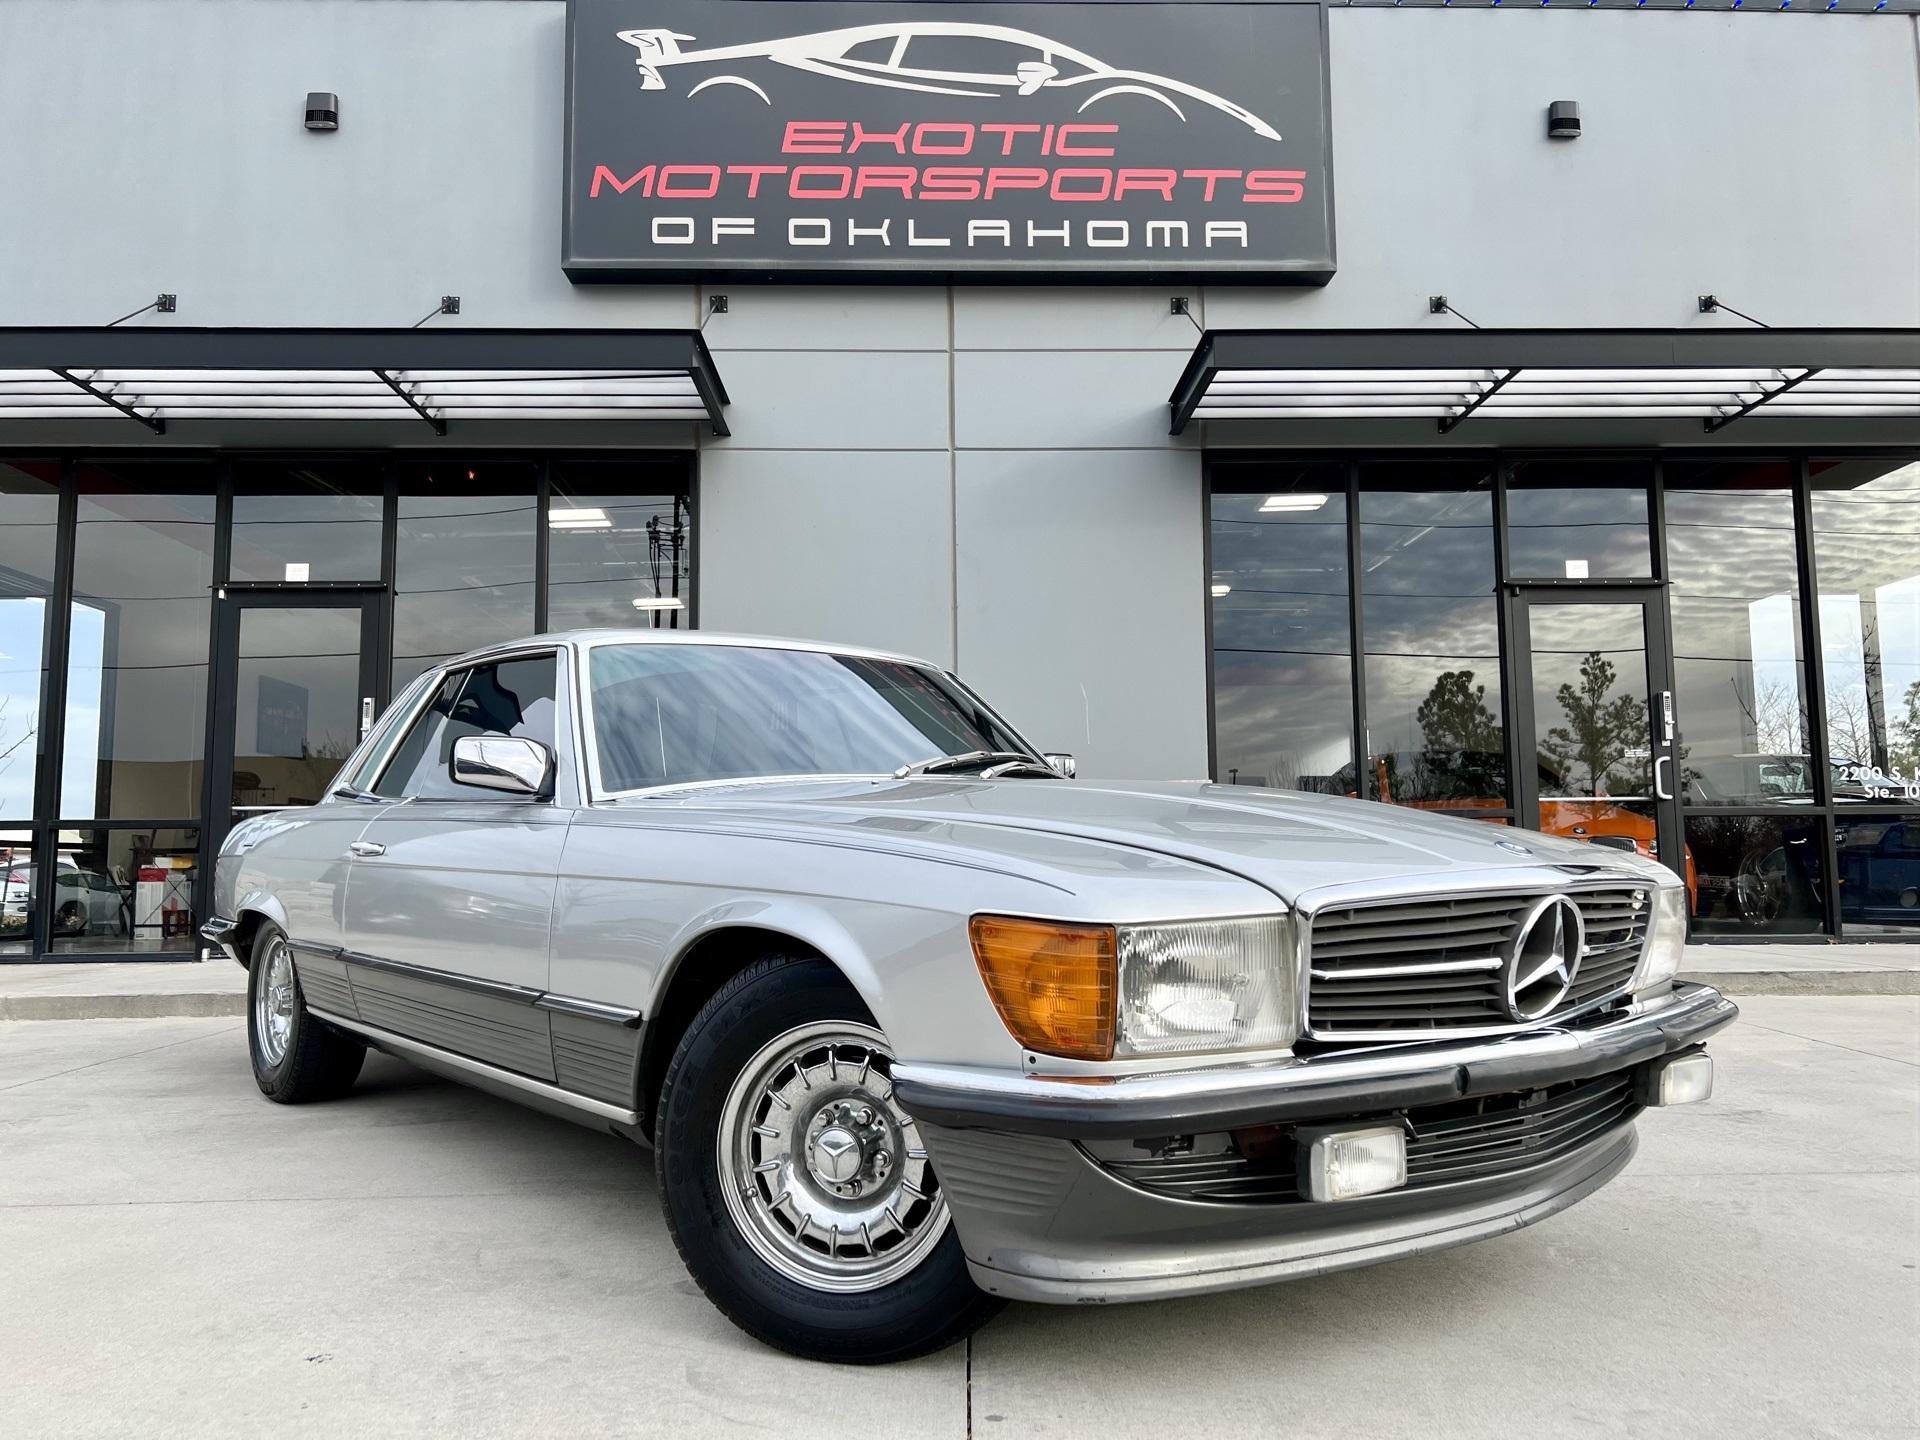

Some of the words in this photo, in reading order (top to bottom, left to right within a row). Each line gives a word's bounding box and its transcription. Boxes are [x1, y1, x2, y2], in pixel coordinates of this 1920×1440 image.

[783, 122, 1118, 157] EXOTIC
[590, 164, 1306, 203] MOTORSPORTS
[651, 217, 755, 245] OF
[788, 218, 1249, 248] OKLAHOMA
[1839, 766, 1882, 781] 2200
[1891, 766, 1906, 780] S.
[1864, 784, 1894, 798] Ste.
